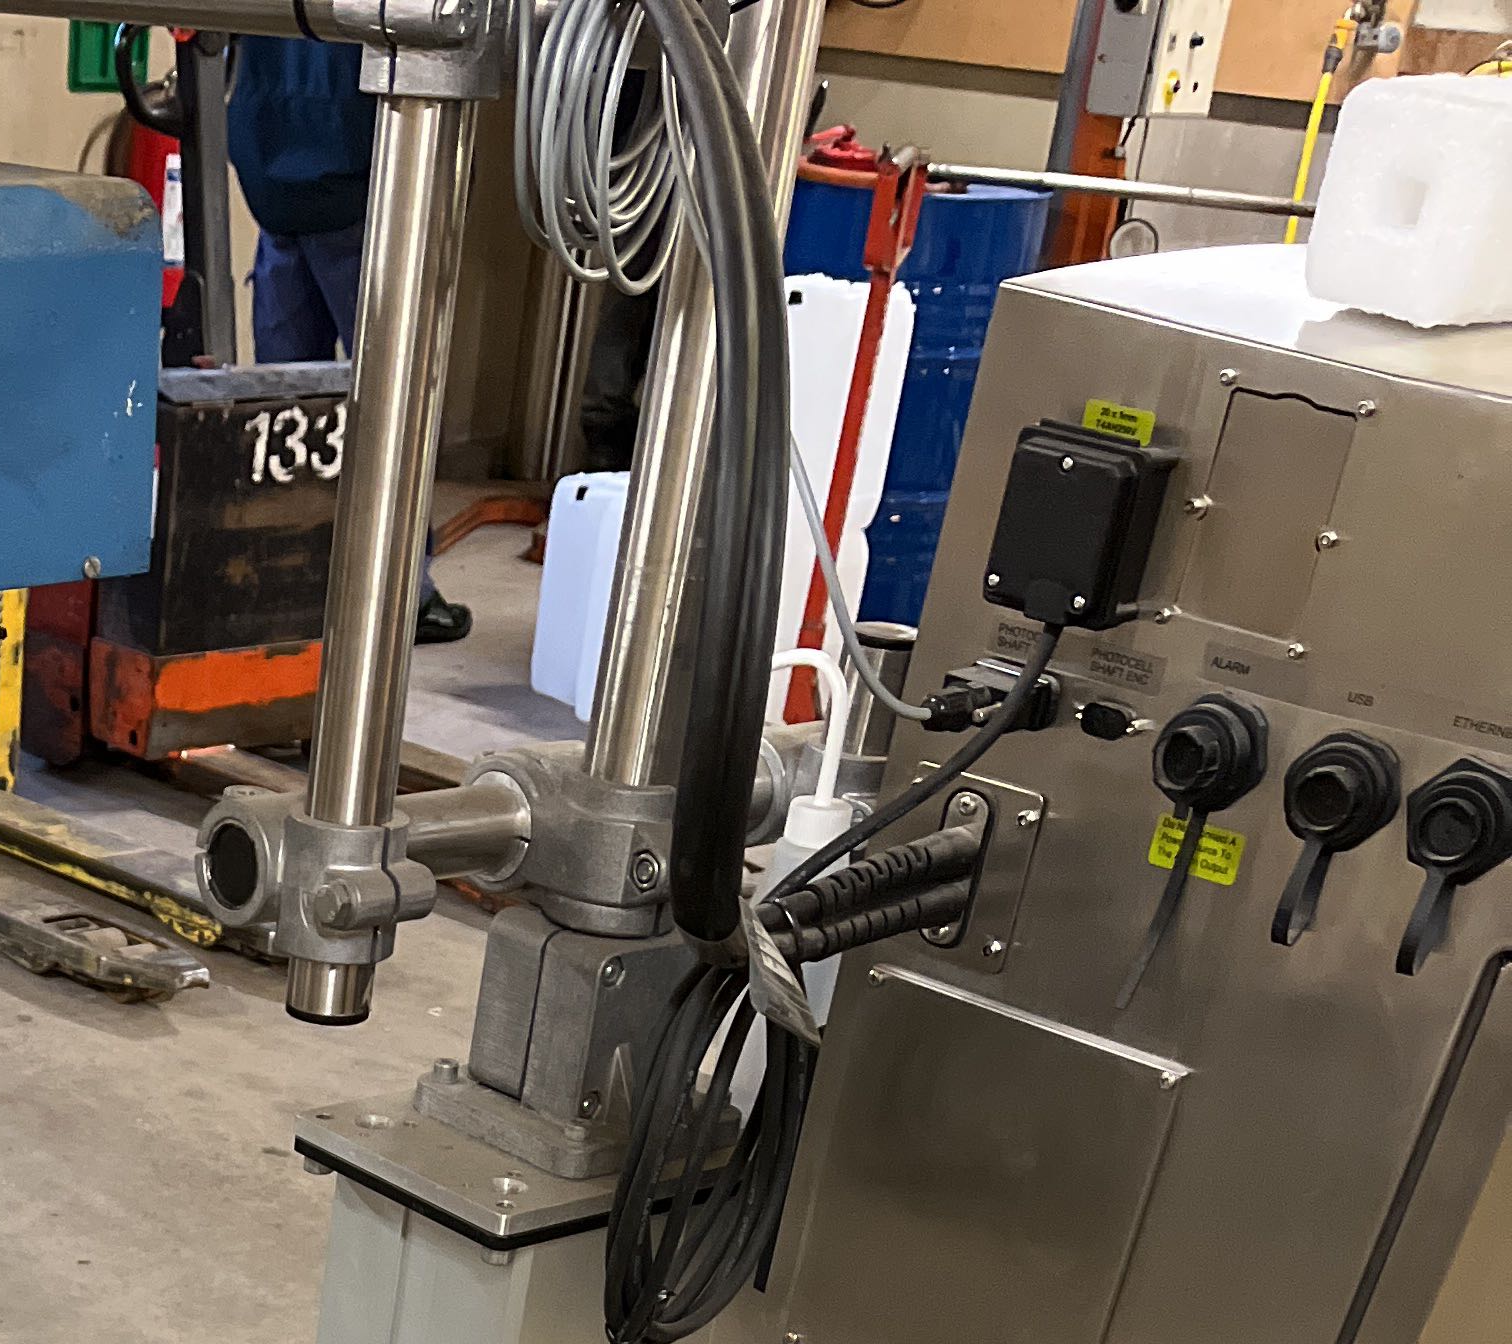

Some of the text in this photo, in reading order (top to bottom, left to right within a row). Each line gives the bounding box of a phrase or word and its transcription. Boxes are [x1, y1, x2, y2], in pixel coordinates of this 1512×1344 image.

[244, 404, 347, 484] 133
[1210, 655, 1251, 676] ALARM
[1347, 691, 1375, 707] USB
